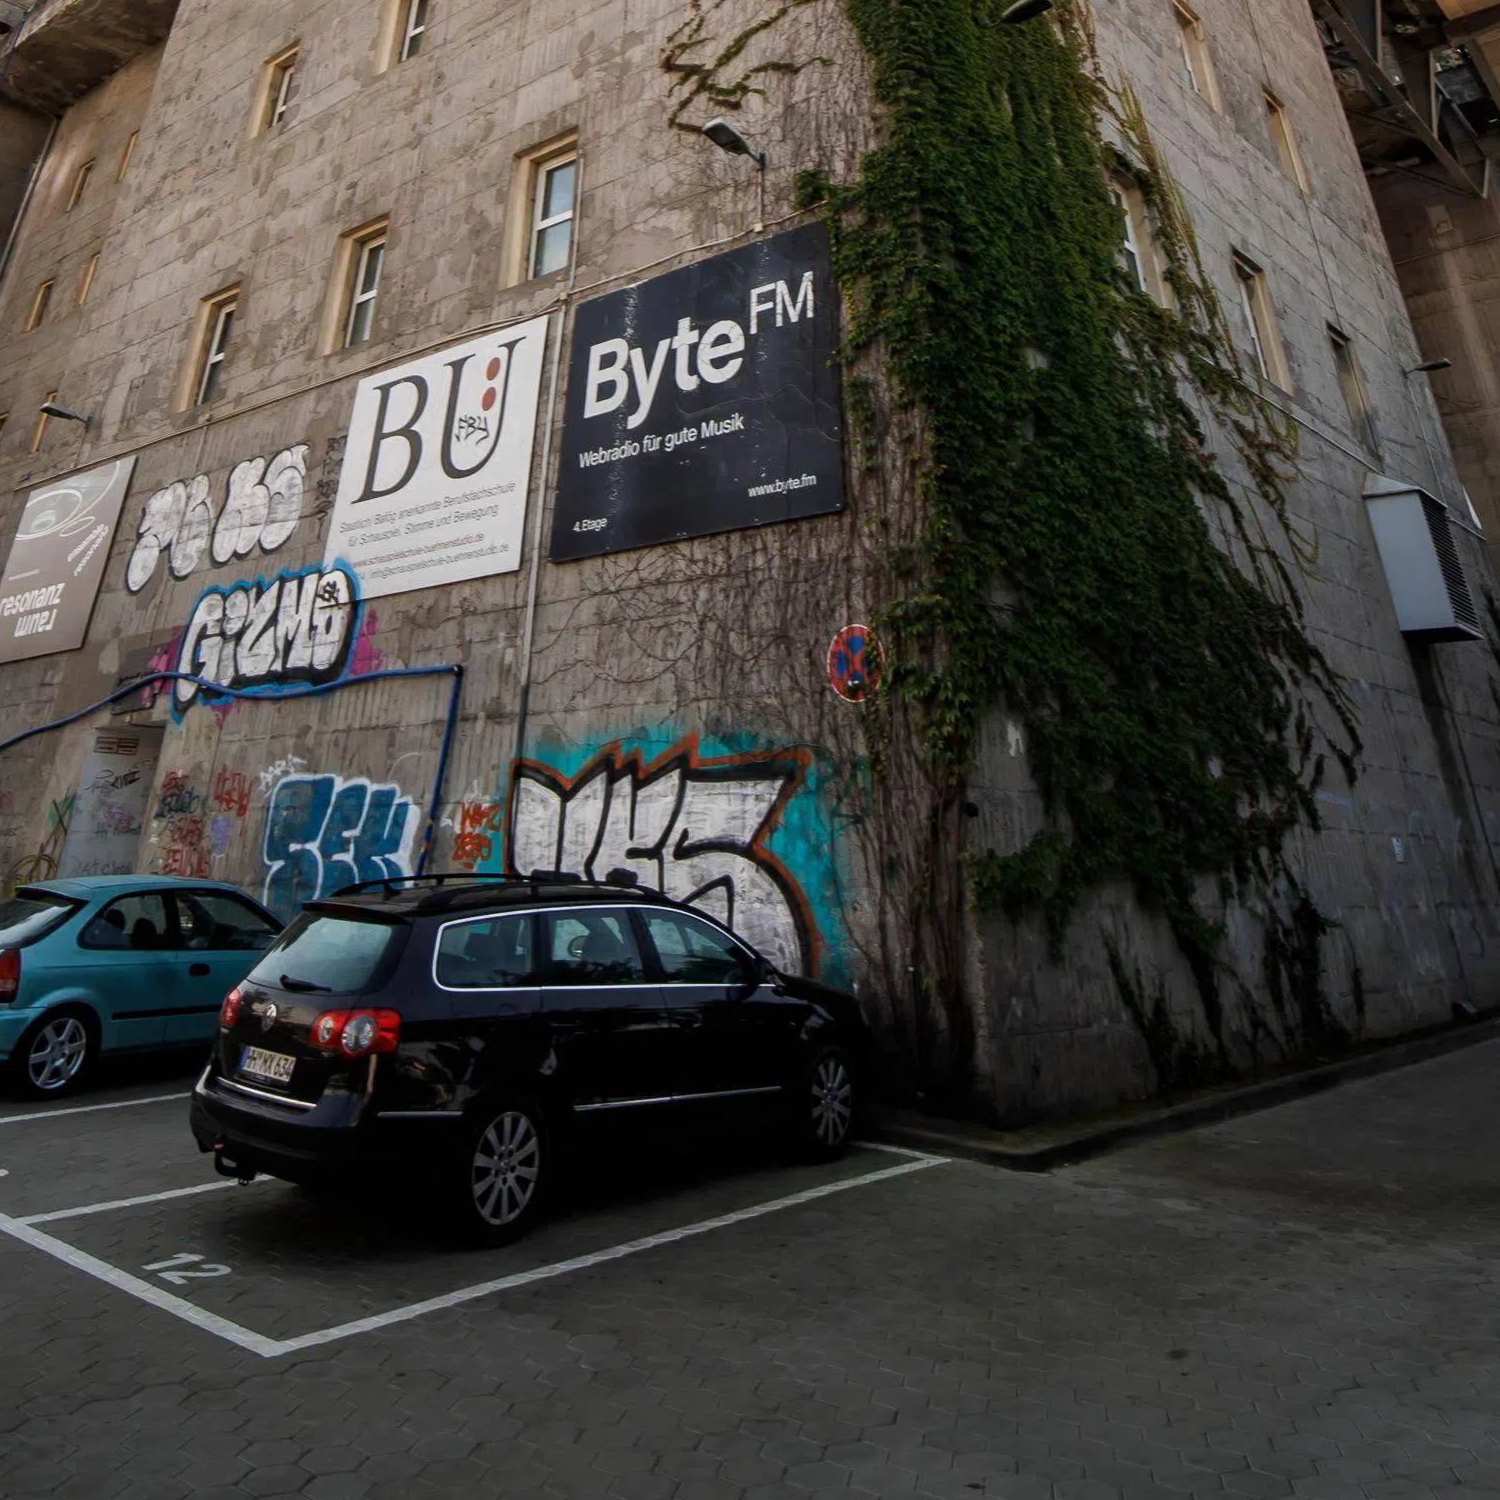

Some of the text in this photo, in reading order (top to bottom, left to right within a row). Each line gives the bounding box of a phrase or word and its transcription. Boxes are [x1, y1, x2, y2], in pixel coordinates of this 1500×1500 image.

[583, 271, 815, 430] Byte FM
[579, 412, 745, 468] Webradio für gute Musik
[398, 501, 442, 520] anerkannte
[443, 482, 516, 508] Berufsfachschule
[748, 473, 817, 498] www.byte.fm
[404, 518, 435, 536] Stimme
[436, 515, 453, 528] und
[453, 504, 499, 524] Bewegung
[582, 517, 608, 532] Etage
[141, 1252, 233, 1286] 12
